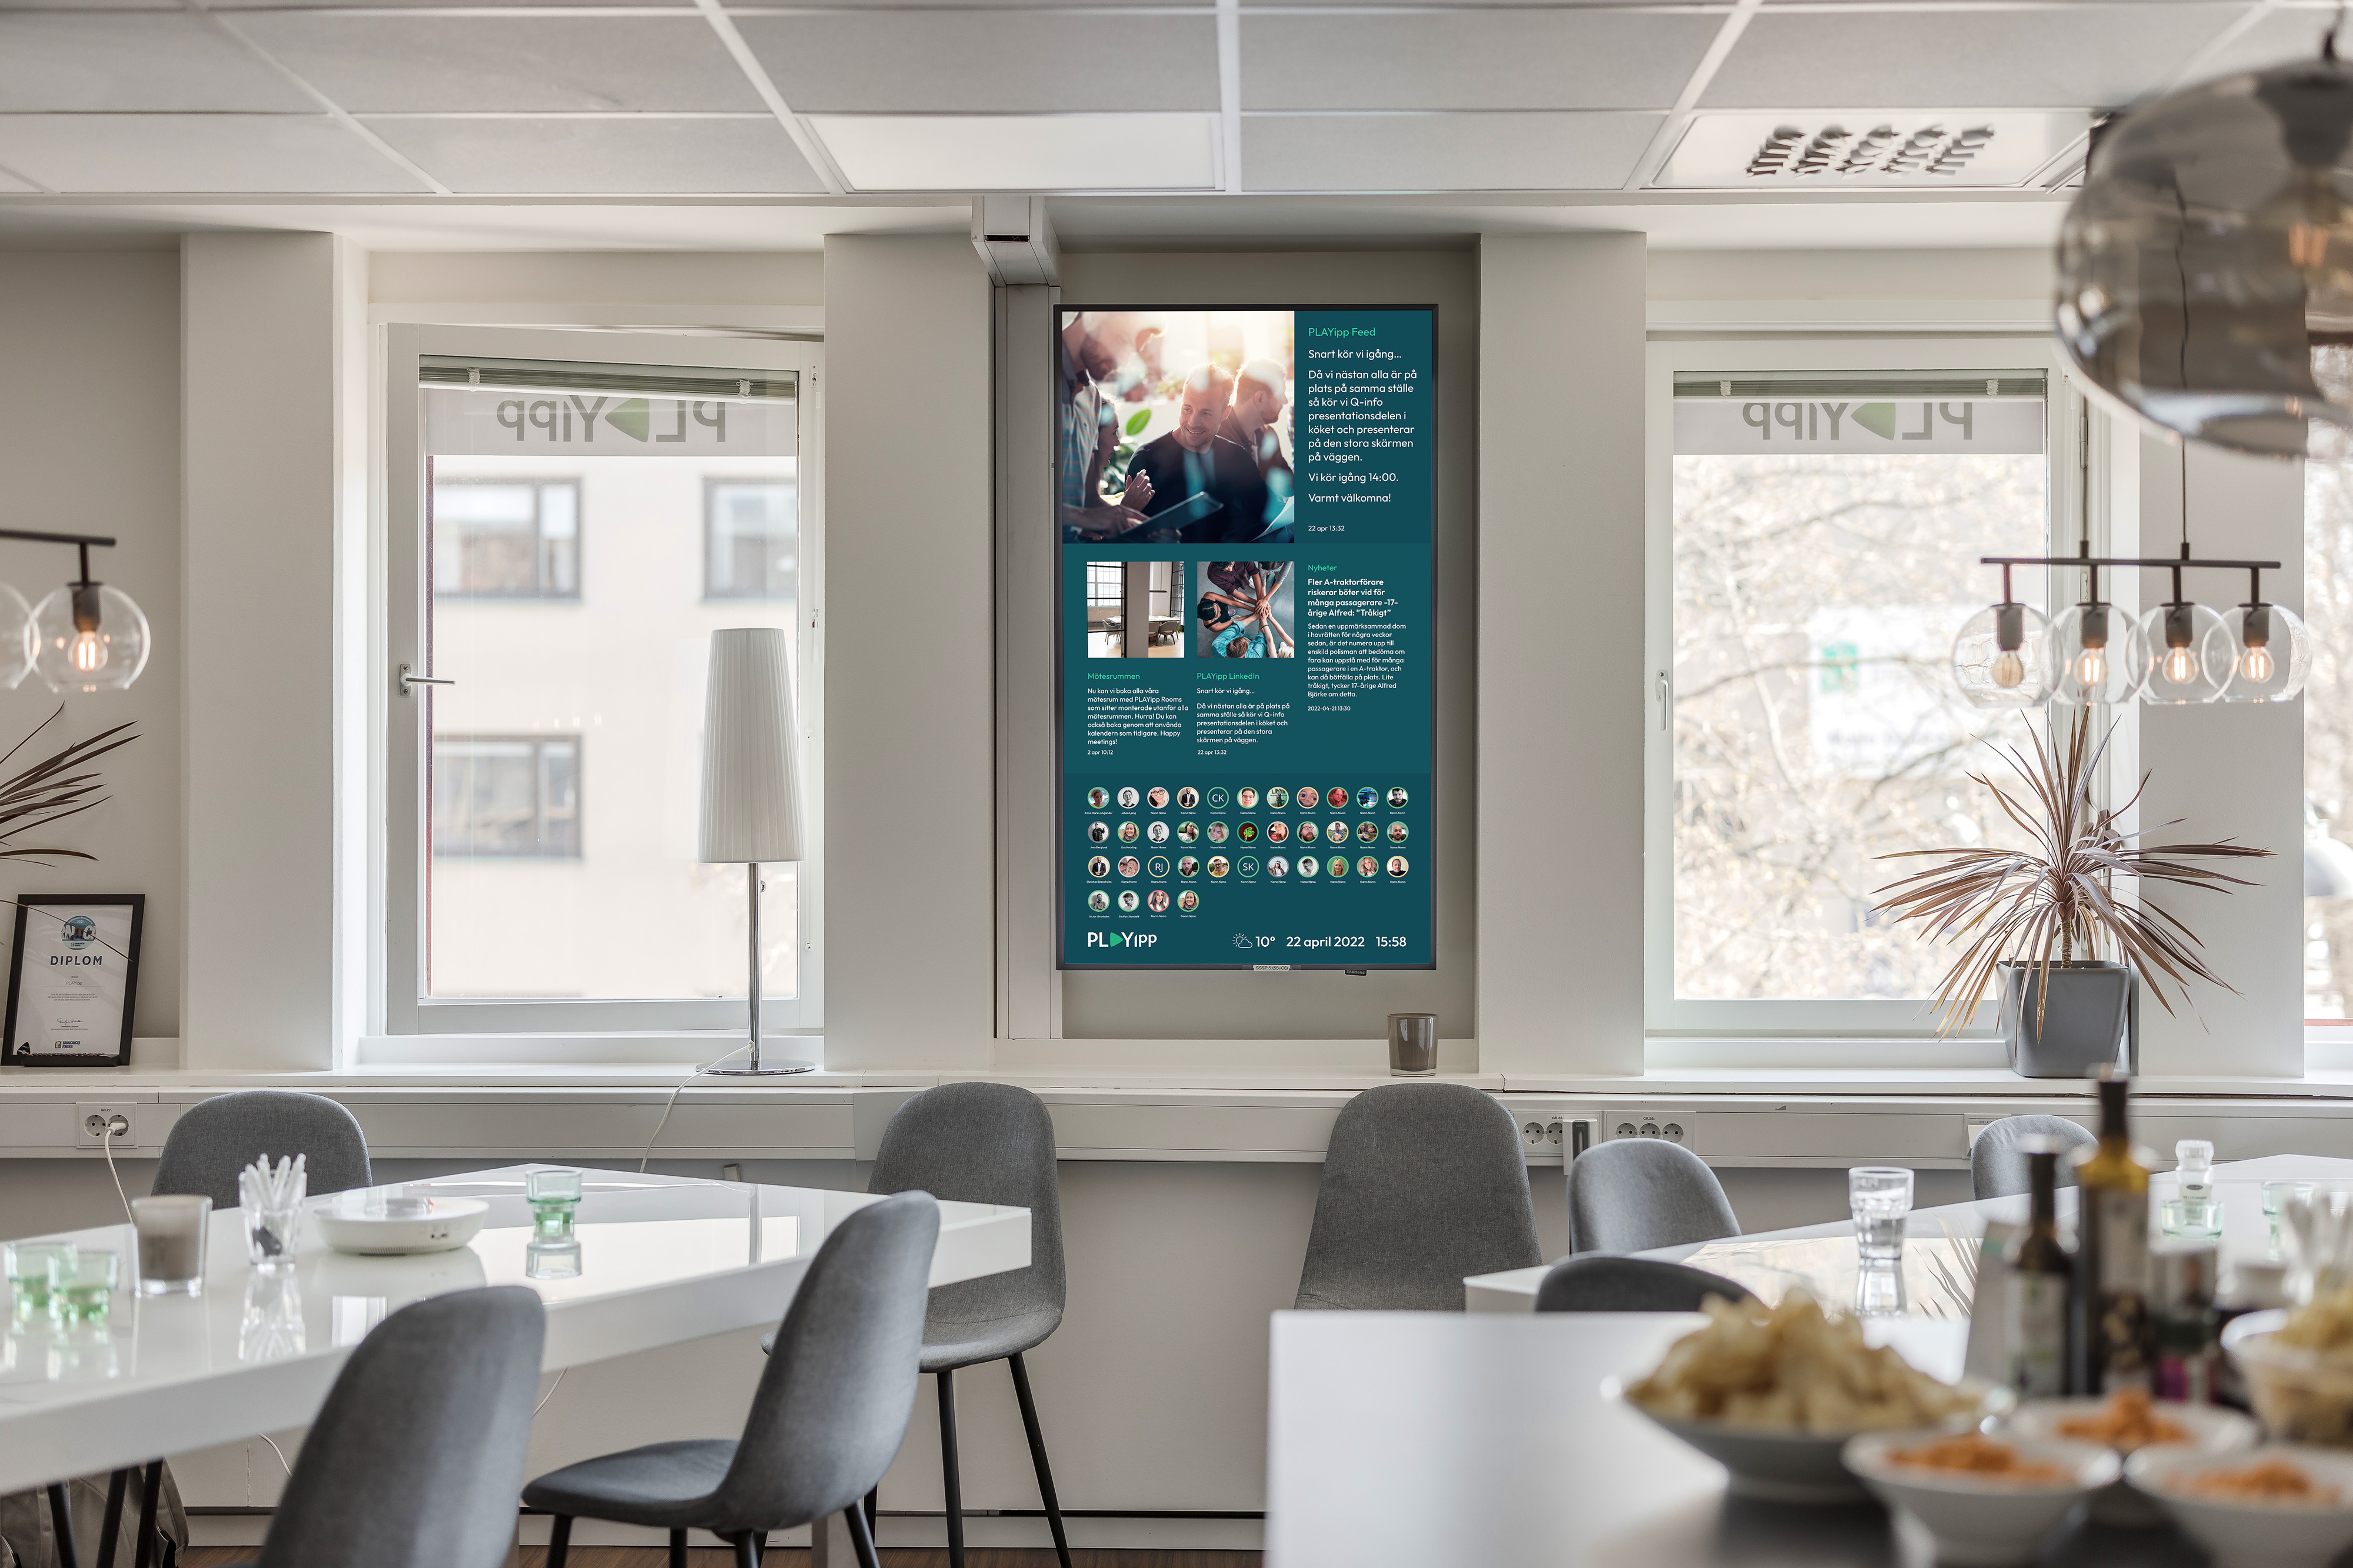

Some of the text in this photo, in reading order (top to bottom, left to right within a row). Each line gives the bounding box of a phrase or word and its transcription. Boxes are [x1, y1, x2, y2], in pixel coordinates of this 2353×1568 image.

[1309, 327, 1375, 338] PLAYipp Feed
[1308, 349, 1335, 358] Snart
[1338, 349, 1354, 358] kör
[1355, 349, 1364, 358] vi
[1308, 369, 1417, 381] Då vi nästan alla är på
[1308, 383, 1332, 395] plats
[1334, 383, 1347, 395] på
[1388, 383, 1414, 393] ställe
[1308, 396, 1383, 406] så kör vi Q-info
[1308, 411, 1406, 422] presentationsdelen i
[1308, 425, 1415, 436] köket och presenterar
[1308, 438, 1414, 450] på den stora skärmen
[1308, 452, 1362, 463] på väggen.
[1308, 472, 1399, 484] Vi kör igång 14:00.
[1308, 493, 1391, 502] Varmt välkomna!
[1308, 598, 1334, 608] många
[1308, 608, 1328, 618] årige
[1382, 656, 1404, 665] många
[1197, 672, 1228, 680] PLAYipp
[1212, 794, 1224, 802] CK
[1155, 863, 1163, 872] RJ
[1242, 863, 1254, 871] SK
[1255, 936, 1407, 950] 10° 22 april 2022 15:58
[50, 955, 102, 965] DIPLOM
